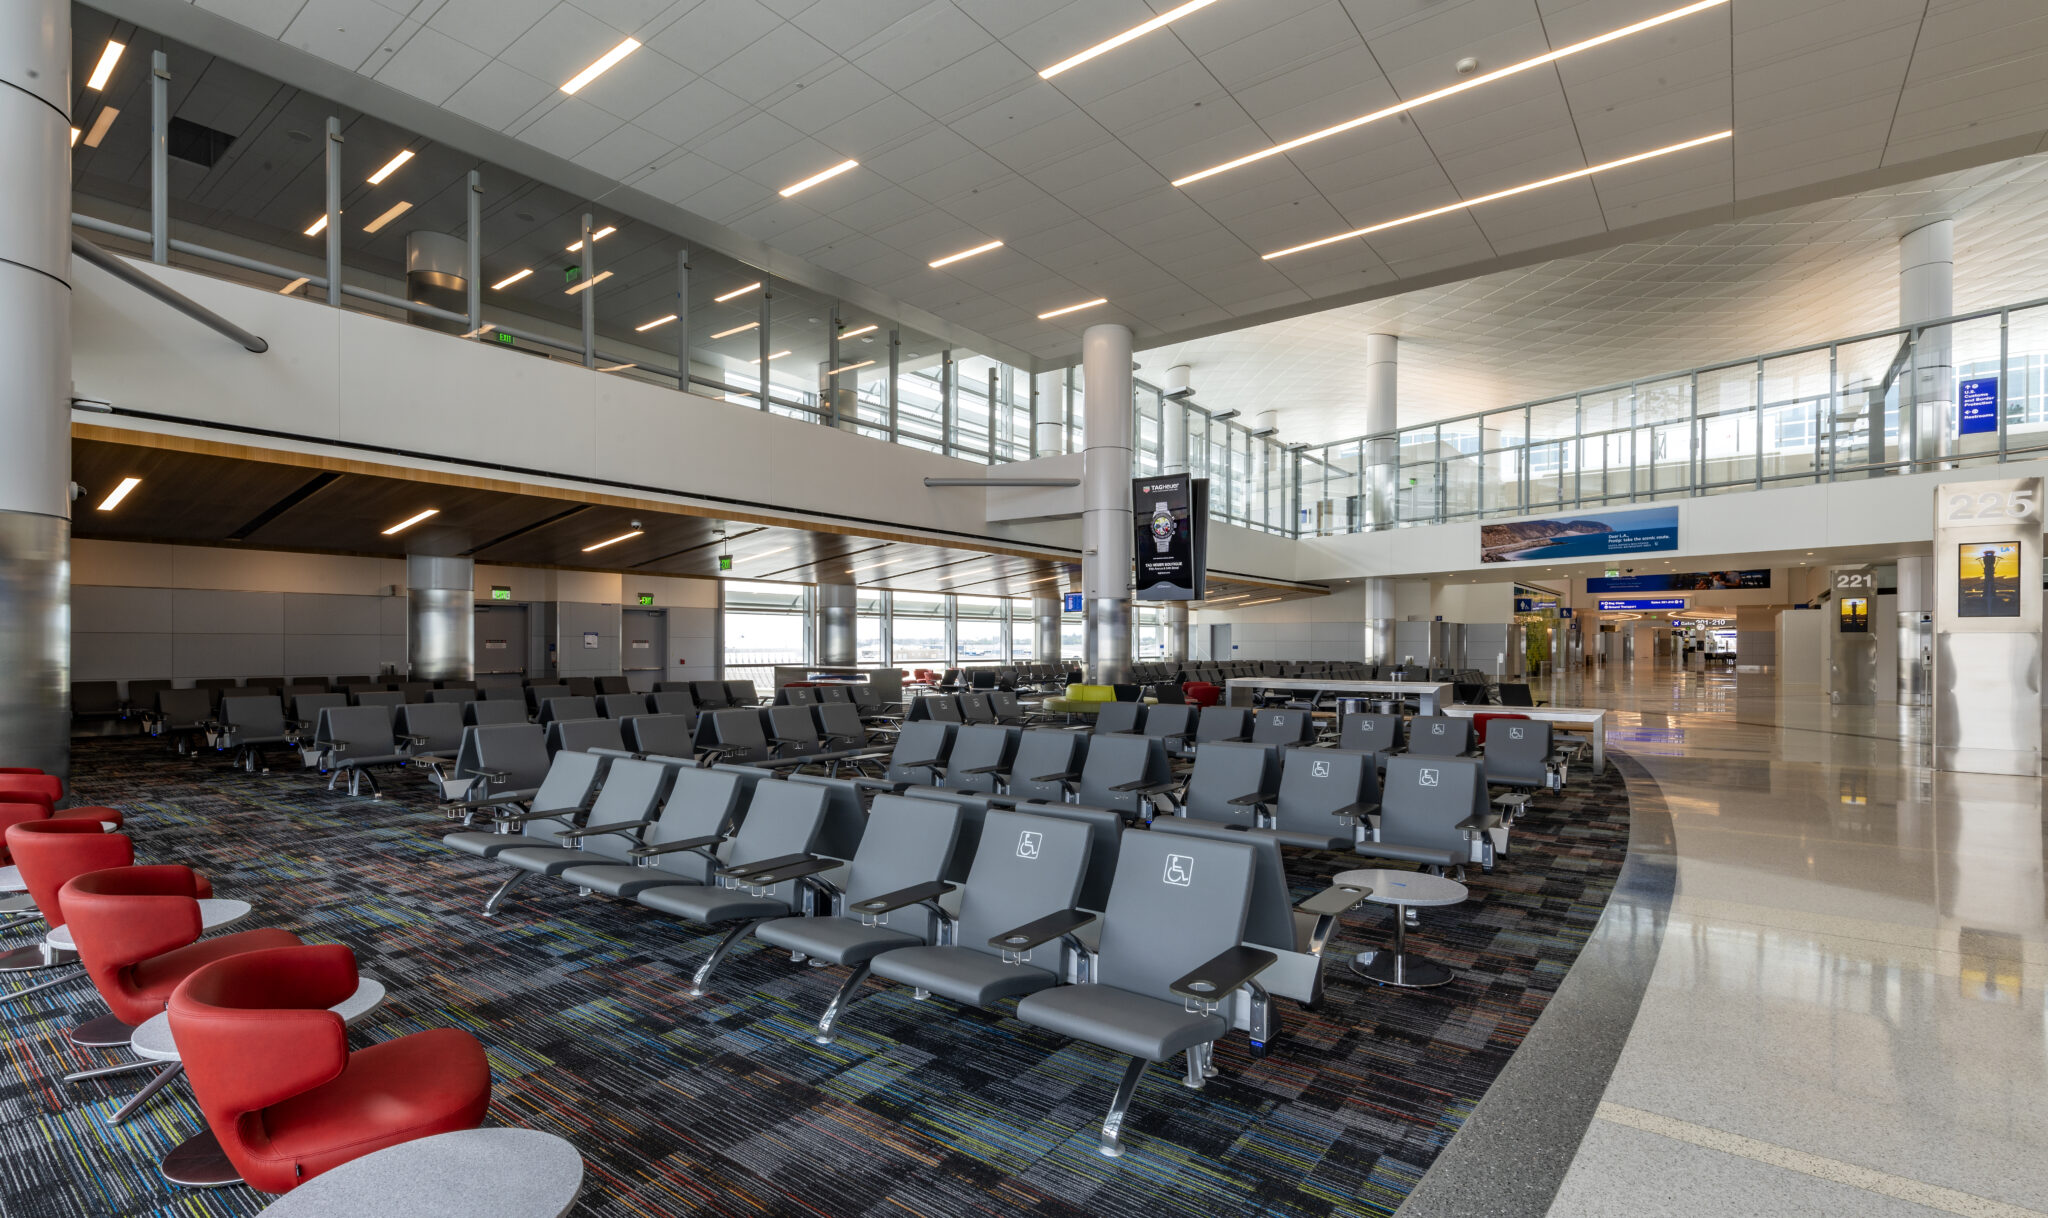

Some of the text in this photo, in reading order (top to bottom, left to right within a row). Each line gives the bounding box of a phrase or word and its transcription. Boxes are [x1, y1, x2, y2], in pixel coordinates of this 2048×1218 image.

[499, 333, 512, 344] EXIT
[1948, 490, 2034, 520] 225
[720, 559, 731, 570] EXIT
[1837, 574, 1872, 588] 221
[641, 596, 652, 605] EXIT
